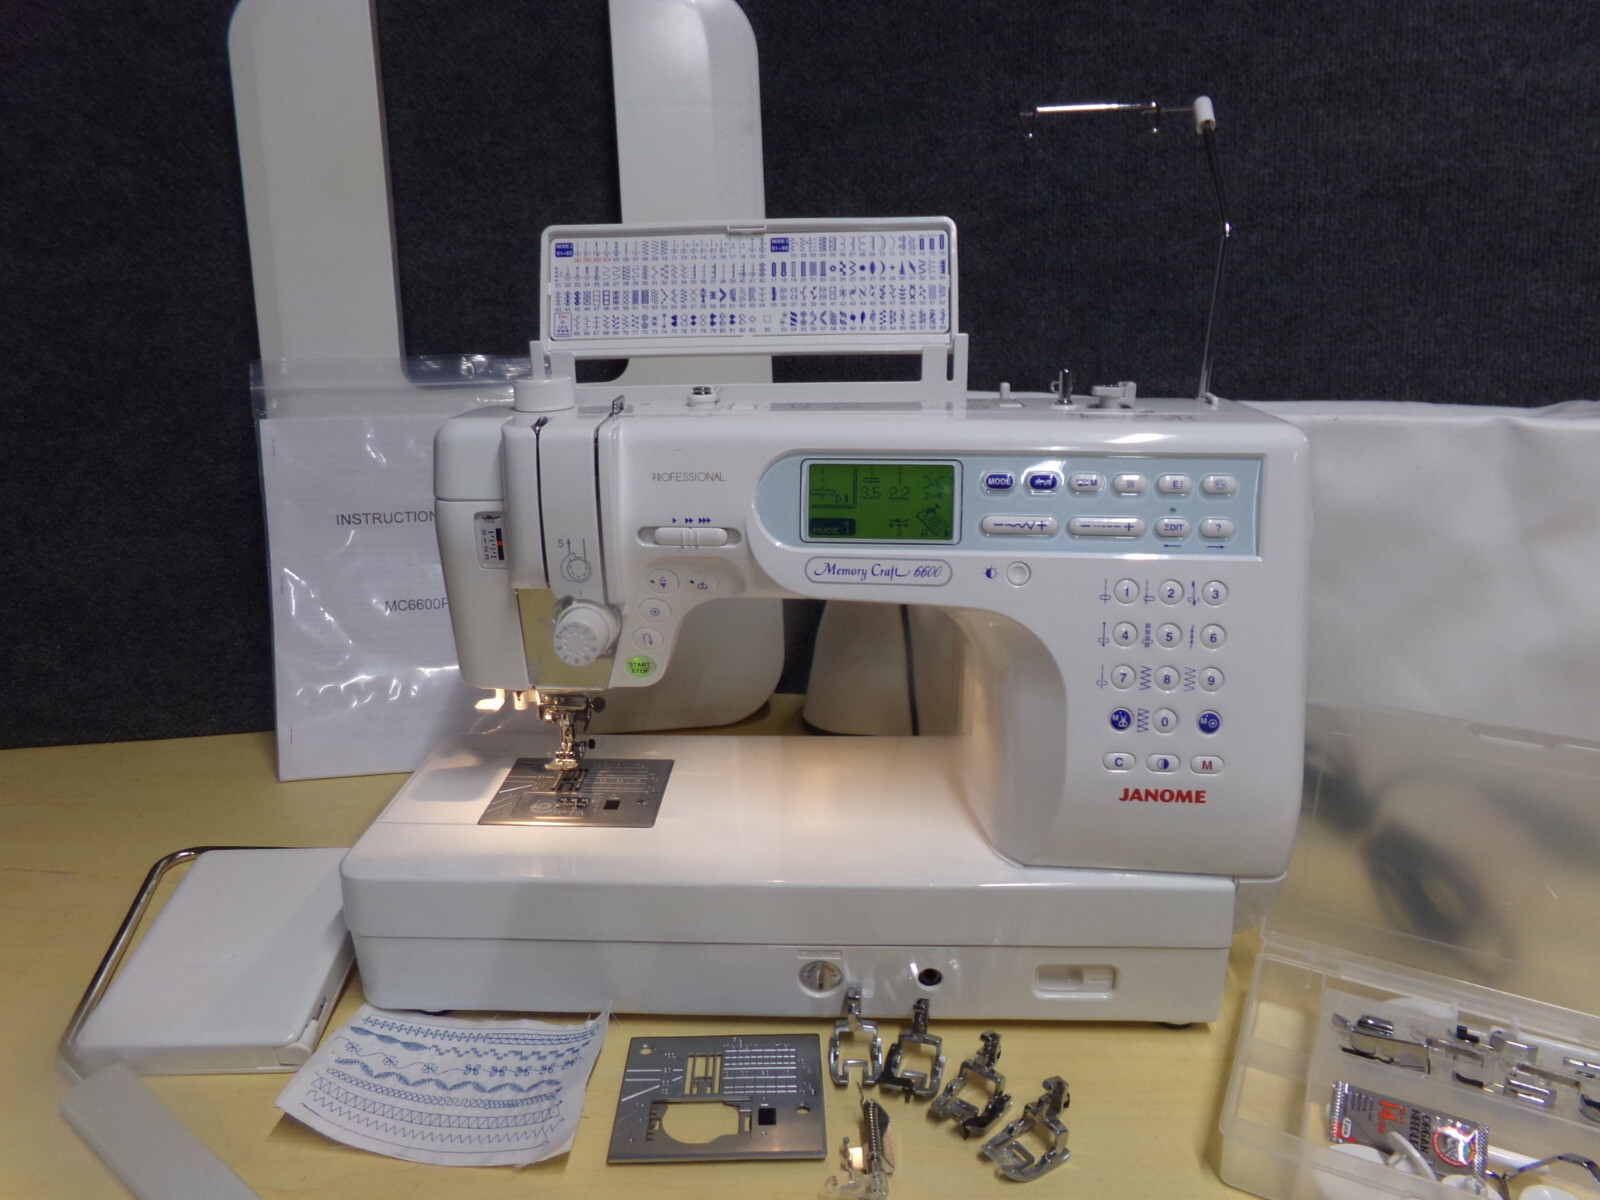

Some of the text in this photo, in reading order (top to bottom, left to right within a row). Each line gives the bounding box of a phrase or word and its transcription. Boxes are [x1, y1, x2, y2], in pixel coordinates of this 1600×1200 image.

[652, 472, 727, 482] PROFESSIONAL
[988, 476, 1012, 486] MODE
[861, 486, 910, 500] 3.5 2.2
[558, 539, 564, 548] 5
[814, 563, 943, 581] Memory Craft 6600
[1125, 588, 1129, 596] 1
[1168, 589, 1175, 598] 2
[1212, 590, 1219, 600] 3
[1122, 631, 1129, 640] 4
[1166, 632, 1173, 642] 5
[1210, 633, 1217, 642] 6
[1120, 673, 1127, 682] 7
[1164, 675, 1170, 684] 8
[1208, 676, 1215, 685] 9
[1161, 717, 1168, 727] 0
[1115, 758, 1124, 767] C
[1203, 761, 1212, 770] M
[1119, 788, 1206, 803] JANOME
[1419, 1113, 1431, 1154] ORGAN
